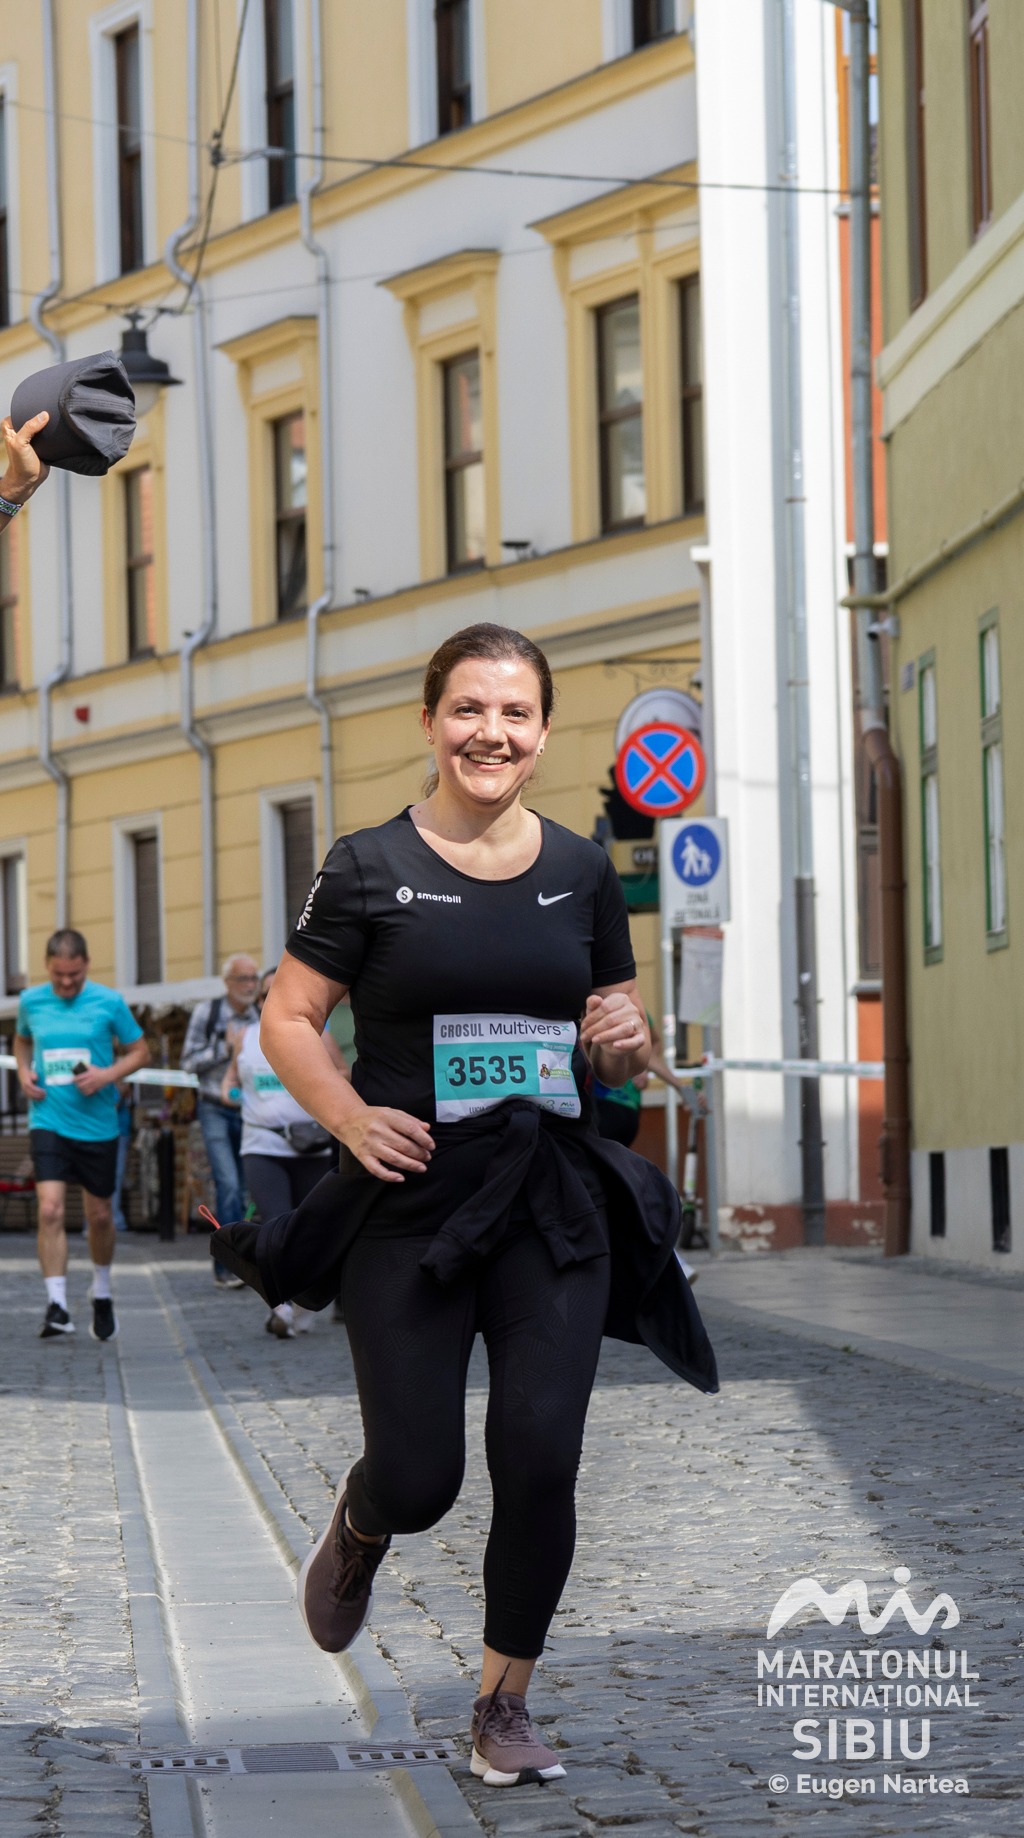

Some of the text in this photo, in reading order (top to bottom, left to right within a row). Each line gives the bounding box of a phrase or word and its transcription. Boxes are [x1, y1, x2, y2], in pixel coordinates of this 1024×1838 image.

[416, 892, 462, 904] smartbill
[440, 1024, 484, 1038] CROSUL
[448, 1055, 526, 1087] 3535
